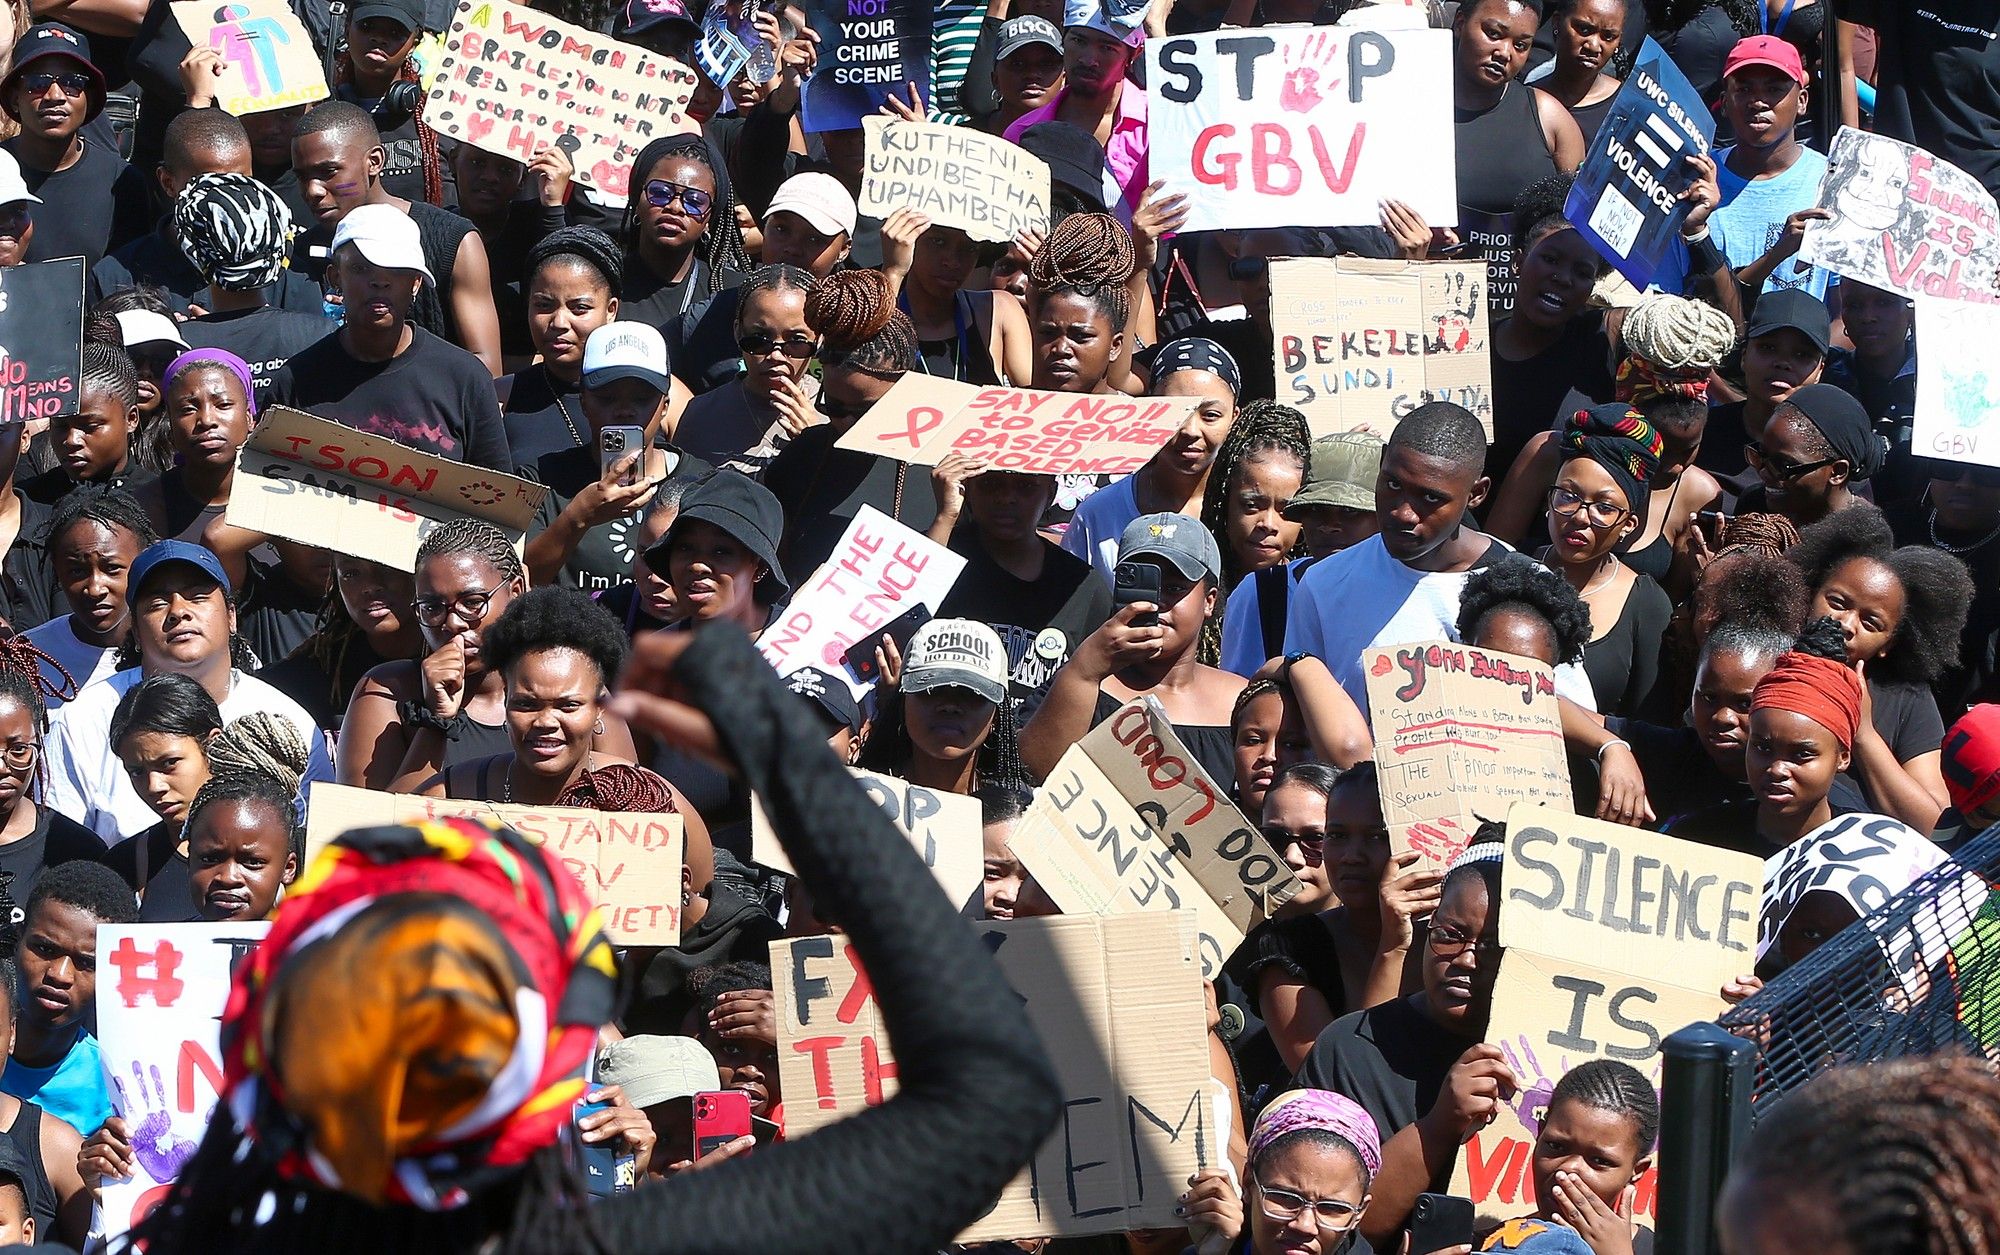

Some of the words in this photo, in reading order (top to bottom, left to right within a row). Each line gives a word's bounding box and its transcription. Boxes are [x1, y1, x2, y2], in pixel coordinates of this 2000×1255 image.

[469, 3, 493, 28] A
[847, 0, 889, 16] NOT
[840, 18, 896, 39] YOUR
[836, 40, 900, 62] CRIME
[834, 63, 903, 84] SCENE
[1637, 71, 1669, 109] UWC
[1666, 101, 1710, 157] SILENCE
[1190, 122, 1367, 197] GBV
[870, 152, 1046, 217] UNDIBETHA
[1606, 135, 1677, 216] VIOLENCE
[1926, 216, 1977, 258] IS
[1479, 249, 1515, 263] JUS
[605, 337, 617, 356] LOS
[618, 332, 649, 358] ANGELES
[27, 397, 62, 419] NO
[968, 389, 1055, 413] SAY
[949, 427, 1083, 457] BASED
[1932, 431, 1978, 455] GBV
[260, 463, 359, 505] SAM
[816, 522, 885, 596] THE
[514, 814, 671, 852] STAND
[1048, 769, 1224, 976] SLENCE
[1509, 826, 1754, 952] SILENCE
[596, 902, 680, 933] IETY
[1546, 974, 1662, 1061] IS
